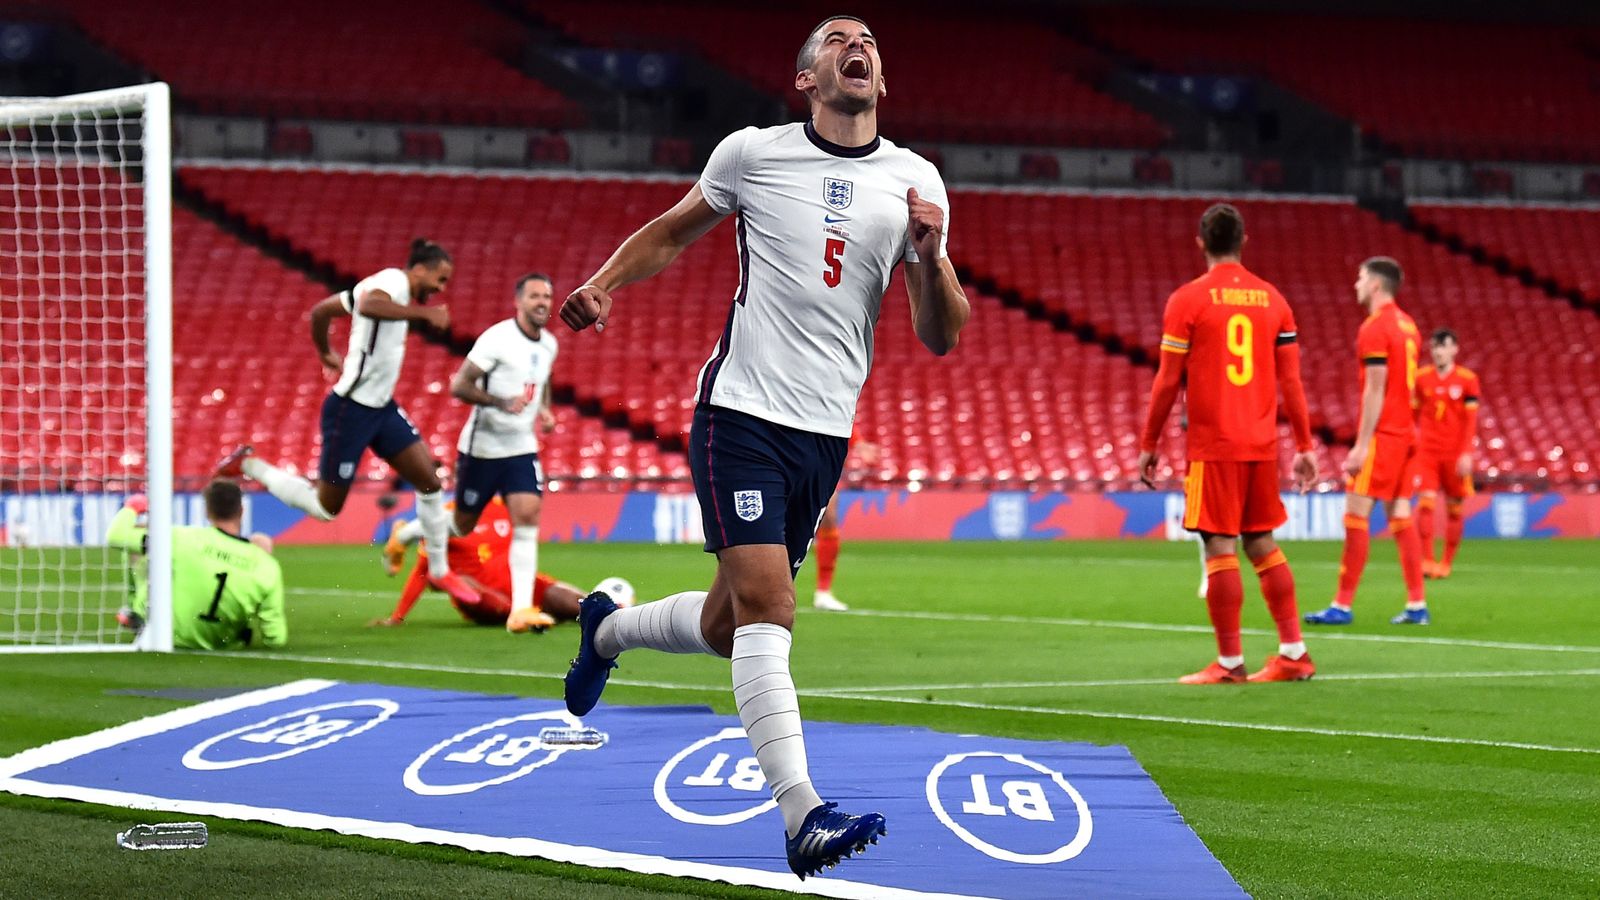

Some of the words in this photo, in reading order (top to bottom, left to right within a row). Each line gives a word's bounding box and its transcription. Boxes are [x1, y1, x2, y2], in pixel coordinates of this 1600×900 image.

[823, 238, 846, 288] 5
[1221, 288, 1270, 308] ROBERTS
[1226, 313, 1254, 387] 9
[198, 572, 228, 623] 1
[239, 714, 355, 746] BT
[444, 733, 542, 767] BT
[682, 752, 767, 792] BT
[962, 774, 1056, 822] BT
